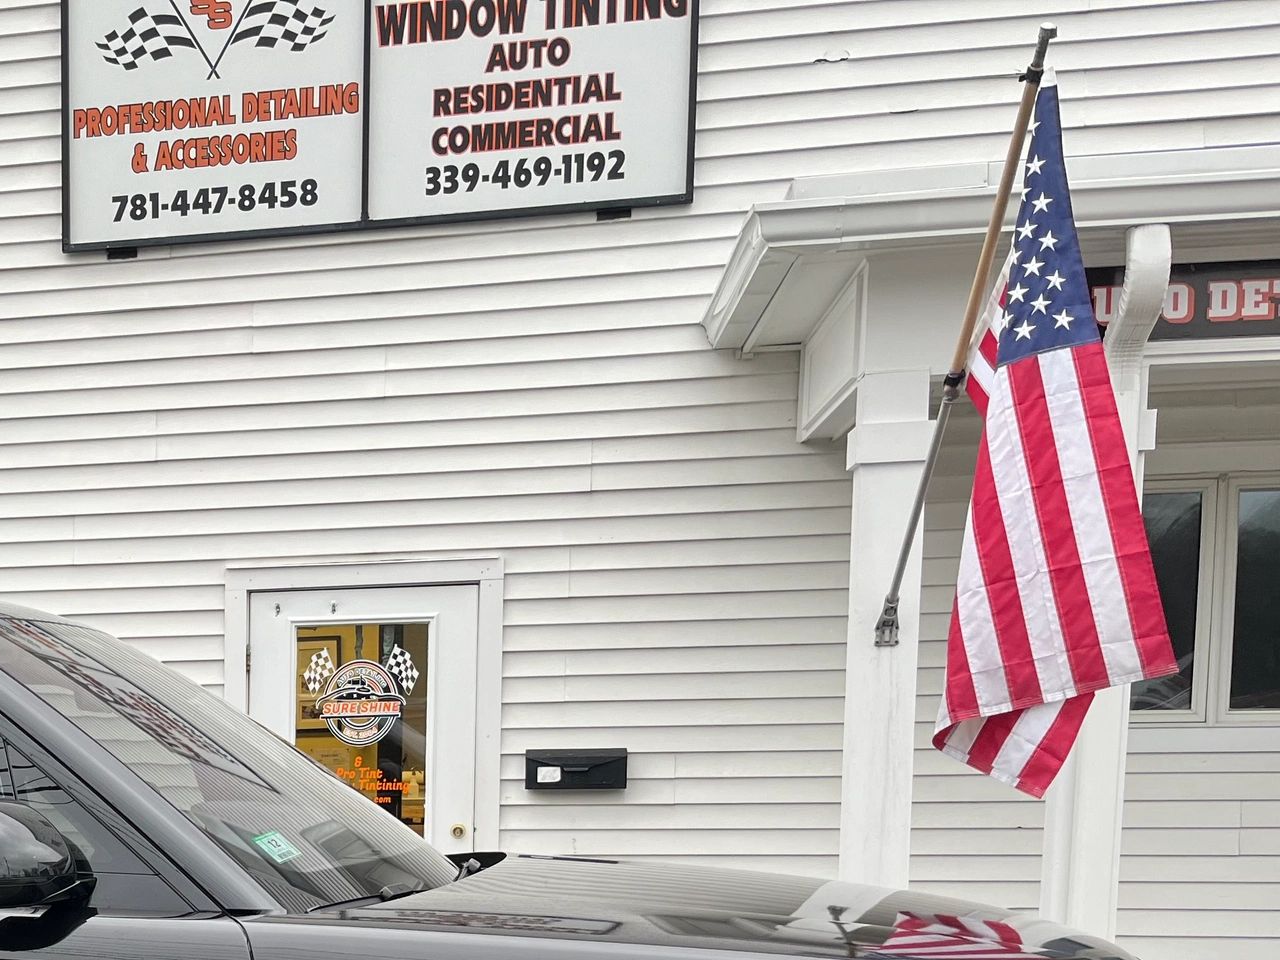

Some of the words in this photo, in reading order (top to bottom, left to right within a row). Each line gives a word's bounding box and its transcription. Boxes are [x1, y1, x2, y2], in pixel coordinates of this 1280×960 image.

[375, 0, 528, 47] WINDOW
[485, 37, 570, 72] AUTO
[73, 94, 237, 139] PROFESSIONAL
[242, 82, 360, 122] DETAILING
[432, 72, 622, 118] RESIDENTIAL
[130, 145, 148, 173] &
[155, 128, 298, 171] ACCESSORIES
[430, 111, 622, 156] COMMERCIAL
[424, 150, 626, 197] 339-469-1192
[111, 178, 319, 222] 781-447-8458
[1093, 281, 1195, 326] UO
[1207, 276, 1280, 323] DE
[337, 670, 355, 687] AUTO
[354, 668, 388, 689] DETAILING
[322, 702, 357, 715] SURE
[360, 700, 401, 714] SHINE
[336, 767, 356, 779] Pro
[359, 766, 383, 779] Tint
[354, 756, 363, 768] &
[359, 778, 411, 794] Tintining
[267, 838, 282, 849] 12
